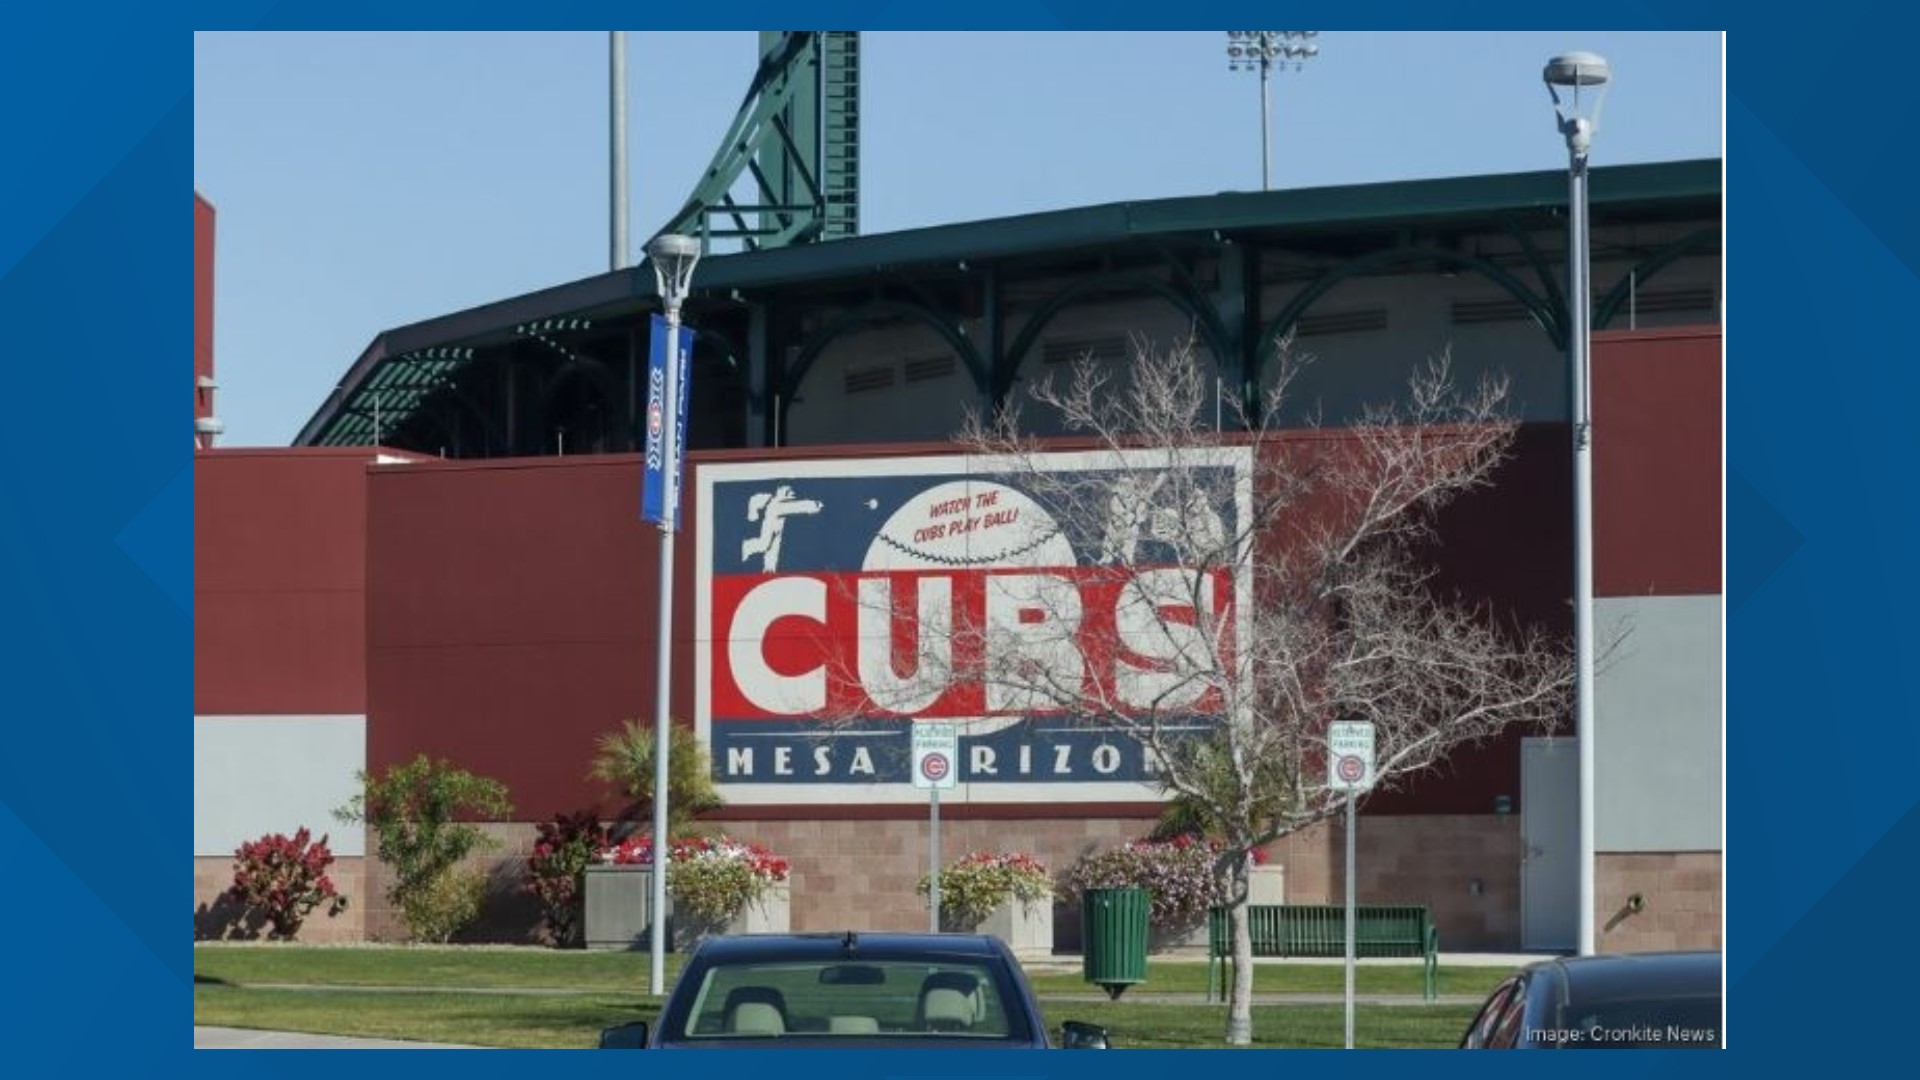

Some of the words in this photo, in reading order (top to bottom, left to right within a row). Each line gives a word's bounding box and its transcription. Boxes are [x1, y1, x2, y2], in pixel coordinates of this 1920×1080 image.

[930, 496, 972, 518] WATCH
[976, 490, 1000, 509] THE
[913, 523, 945, 544] CUBS
[949, 517, 981, 537] PLAY
[984, 507, 1019, 528] BALL!
[728, 568, 1215, 716] CUBS
[727, 746, 875, 775] MESA
